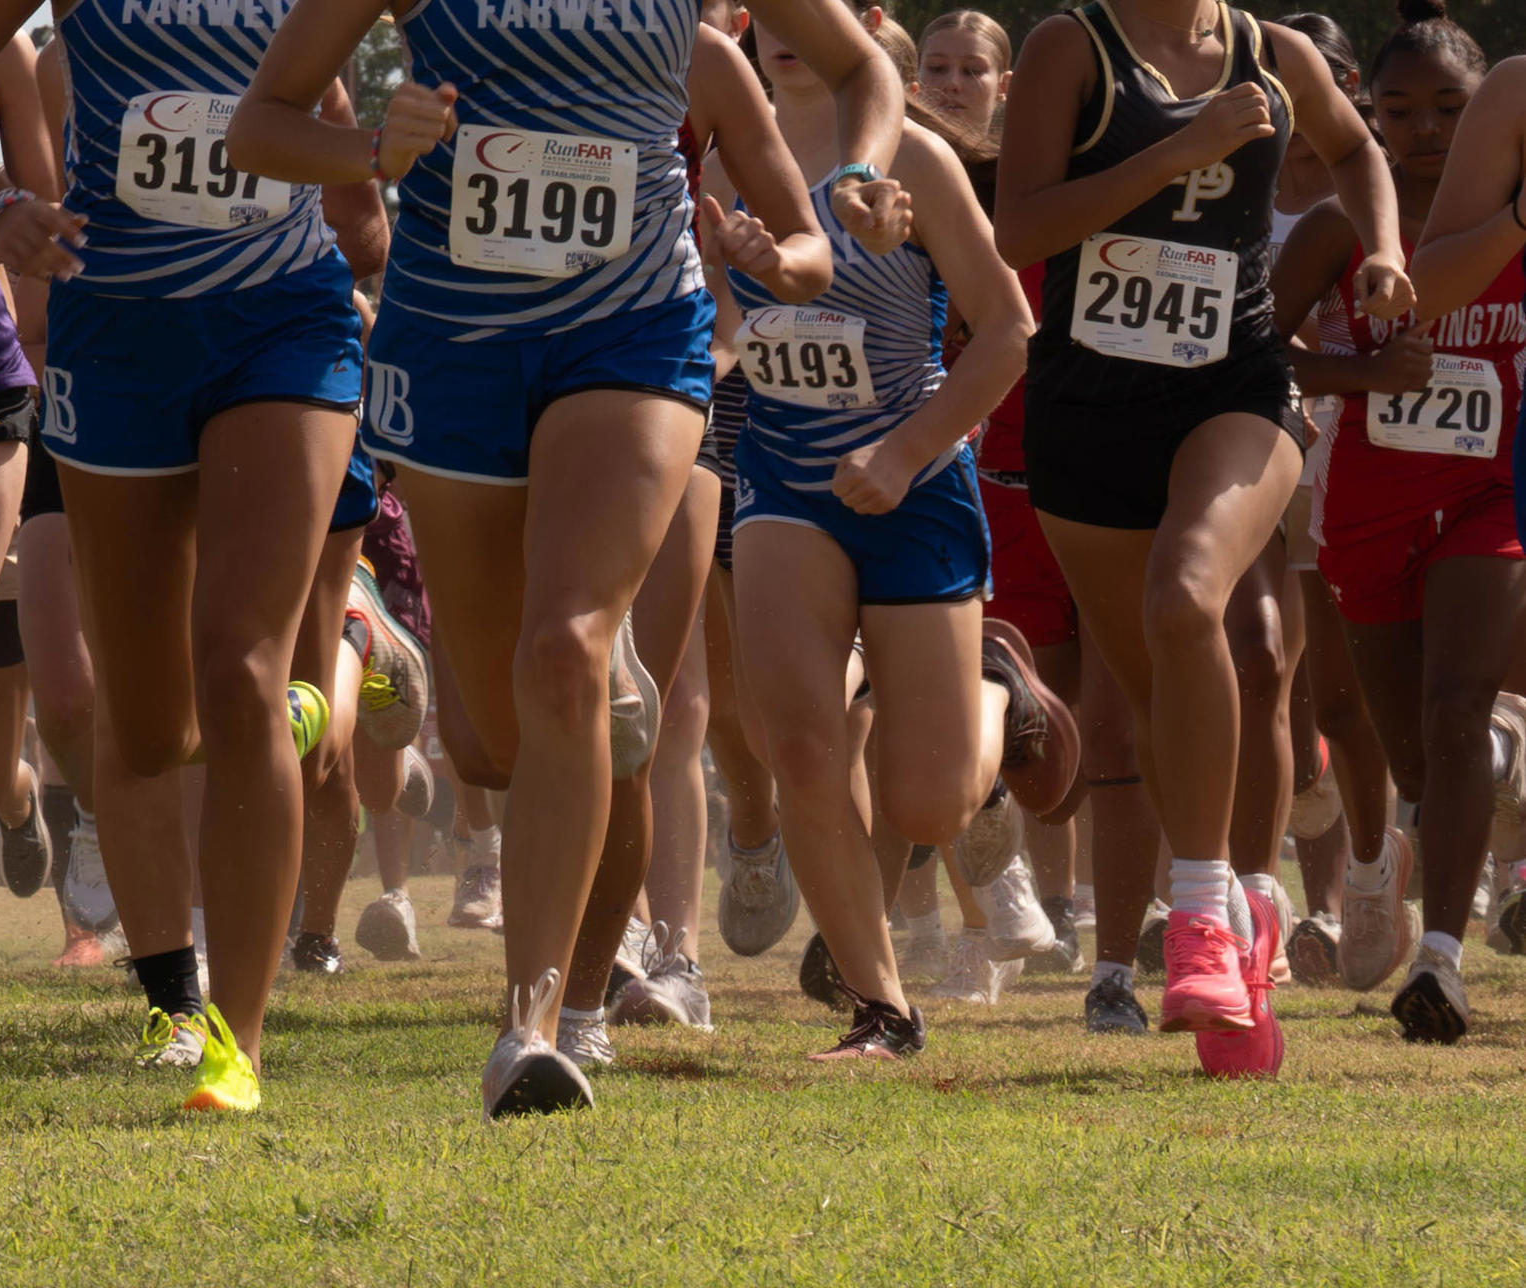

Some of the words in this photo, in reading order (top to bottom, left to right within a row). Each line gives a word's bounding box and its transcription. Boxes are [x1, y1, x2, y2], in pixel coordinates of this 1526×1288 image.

[544, 139, 612, 161] RunFAR
[465, 173, 617, 248] 3199
[1159, 245, 1216, 266] RunFAR
[1084, 271, 1222, 340] 2945
[748, 341, 858, 389] 3193
[1436, 357, 1484, 372] RunFAR
[1378, 387, 1492, 433] 3720
